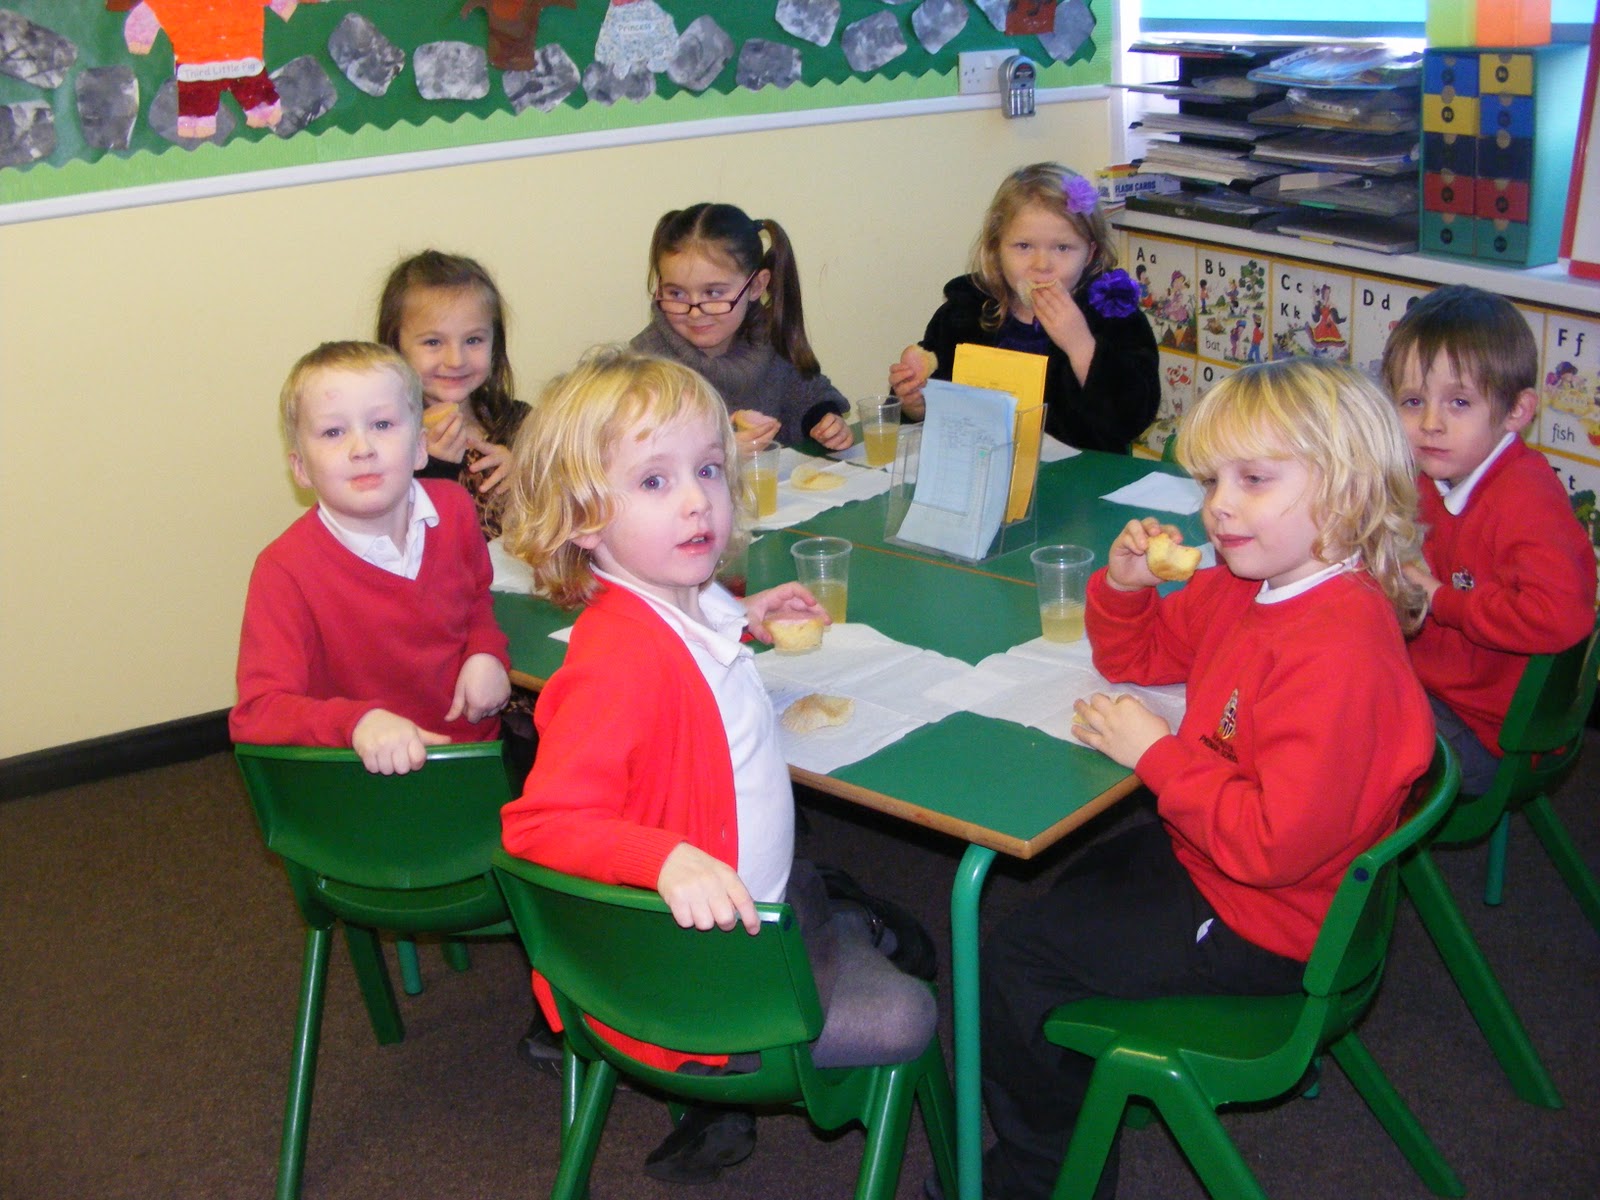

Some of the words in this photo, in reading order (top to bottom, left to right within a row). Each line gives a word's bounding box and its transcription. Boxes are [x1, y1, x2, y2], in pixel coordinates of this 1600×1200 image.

[185, 67, 211, 79] Third
[213, 63, 240, 74] Little
[242, 61, 256, 73] Pig
[1115, 183, 1134, 193] FLASH
[1135, 180, 1156, 191] CARDS
[1136, 246, 1145, 262] A
[1150, 254, 1157, 264] a
[1205, 259, 1213, 275] B
[1218, 261, 1226, 277] b
[1281, 274, 1291, 291] C
[1296, 282, 1303, 293] c
[1363, 289, 1374, 306] D
[1381, 294, 1390, 310] d
[1280, 302, 1289, 317] K
[1293, 305, 1300, 319] k
[1205, 336, 1220, 351] bat
[1558, 328, 1568, 347] F
[1574, 332, 1585, 357] f
[1552, 423, 1575, 443] fish
[1568, 475, 1576, 490] t
